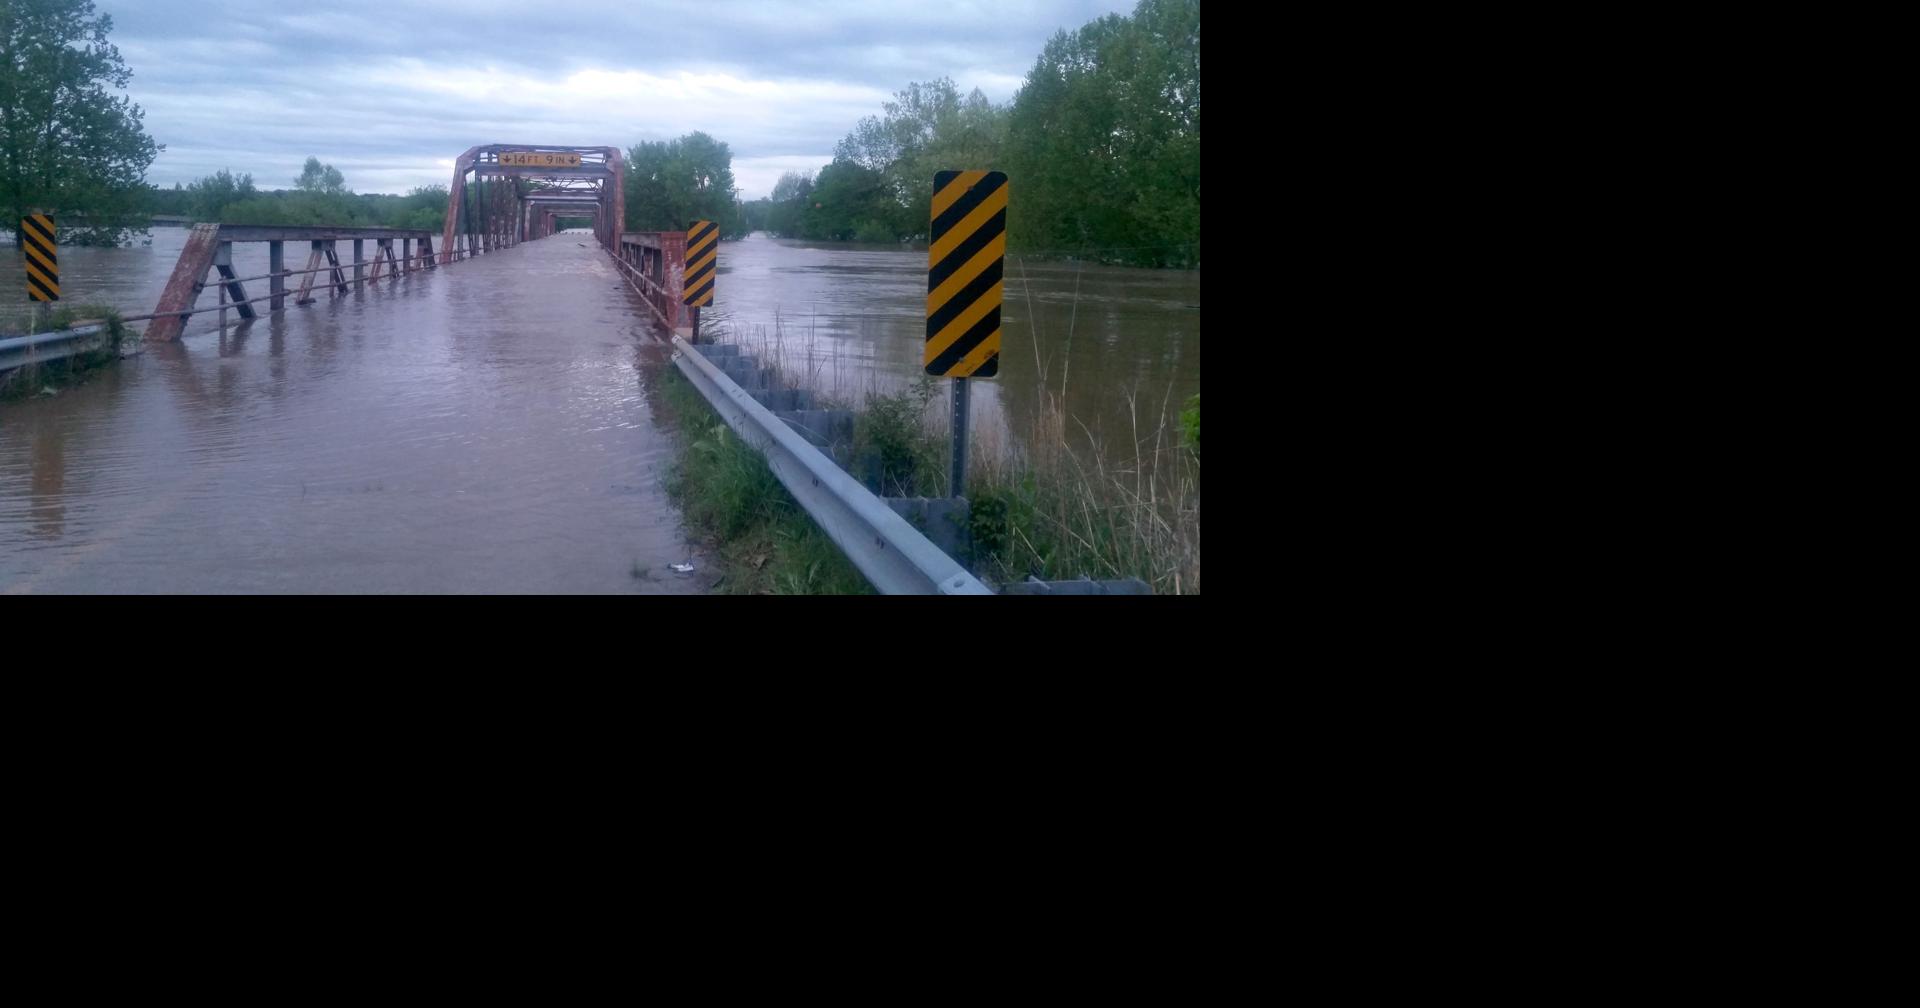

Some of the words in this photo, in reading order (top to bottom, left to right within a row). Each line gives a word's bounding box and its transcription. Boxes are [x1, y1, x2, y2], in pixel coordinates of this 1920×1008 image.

[514, 155, 525, 164] 14
[527, 155, 538, 164] FT
[545, 155, 553, 164] 9
[555, 156, 565, 164] IN
